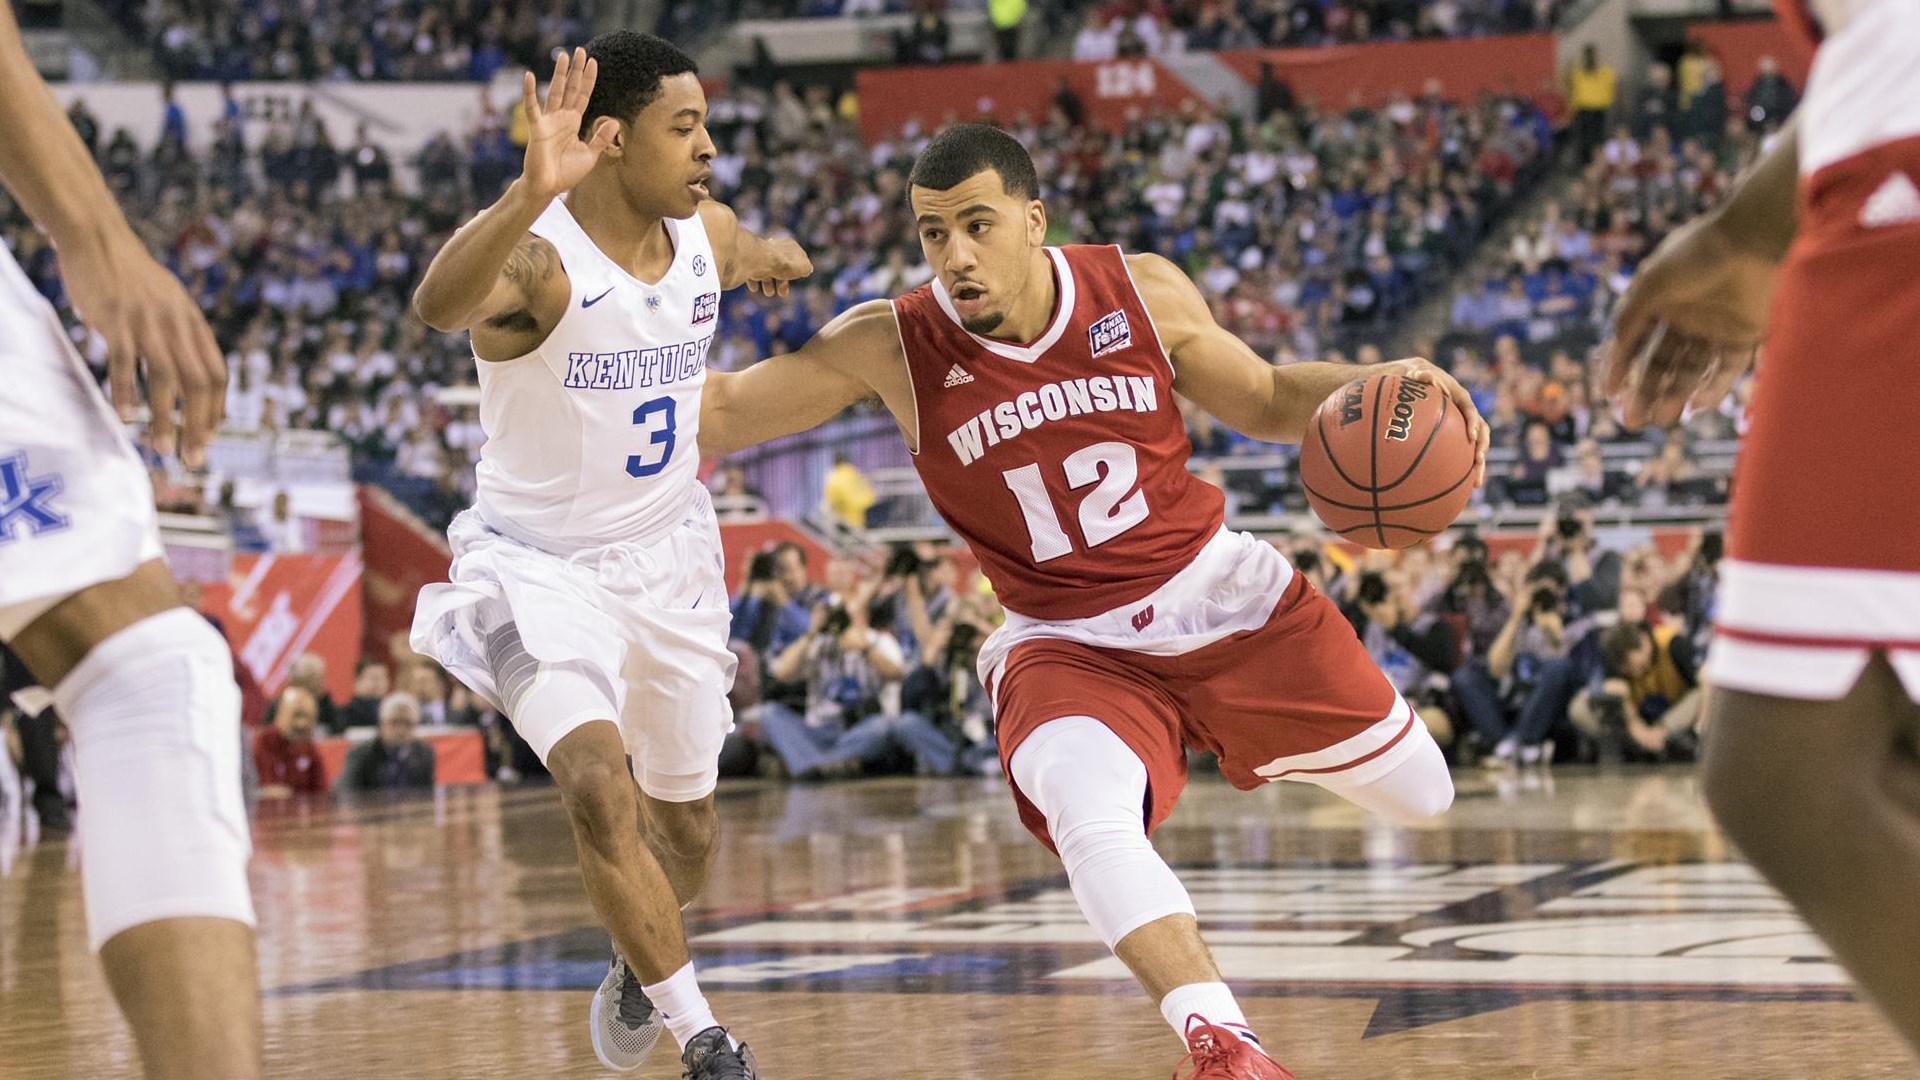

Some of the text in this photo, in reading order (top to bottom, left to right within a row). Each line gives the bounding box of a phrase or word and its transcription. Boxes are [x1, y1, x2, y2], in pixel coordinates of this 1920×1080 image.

[1094, 321, 1128, 351] FOUR
[1100, 314, 1125, 334] FINAL
[943, 374, 975, 388] adidas
[625, 395, 677, 478] 3
[947, 375, 1158, 467] WISCONSIN
[1002, 441, 1150, 563] 12
